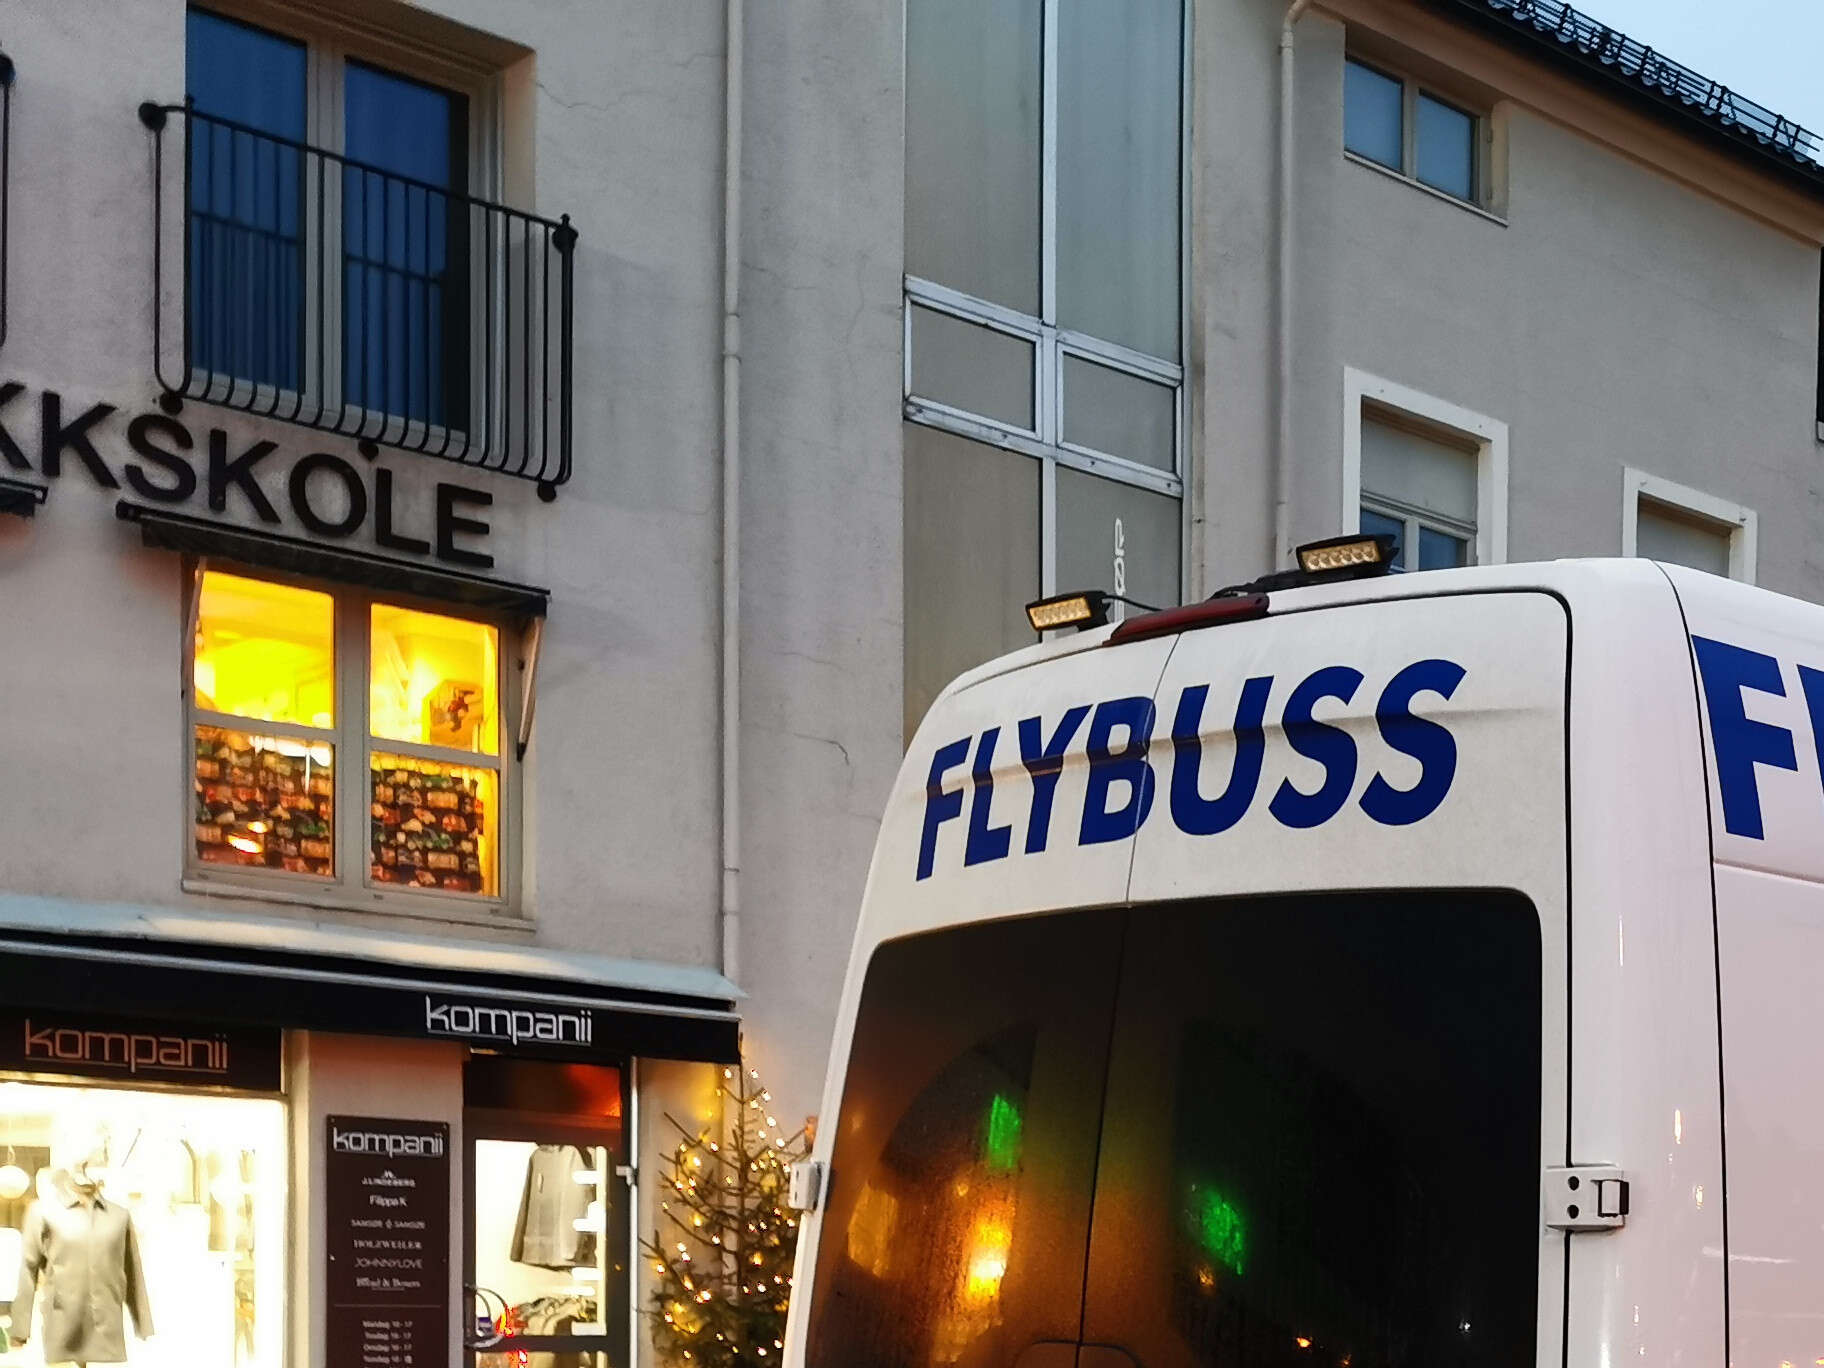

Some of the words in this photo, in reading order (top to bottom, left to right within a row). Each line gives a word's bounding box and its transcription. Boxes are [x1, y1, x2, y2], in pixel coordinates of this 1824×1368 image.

[916, 658, 1467, 882] FLYBUSS
[25, 1018, 227, 1073] kompanii
[425, 995, 592, 1046] kompanii
[333, 1127, 444, 1158] kompanii
